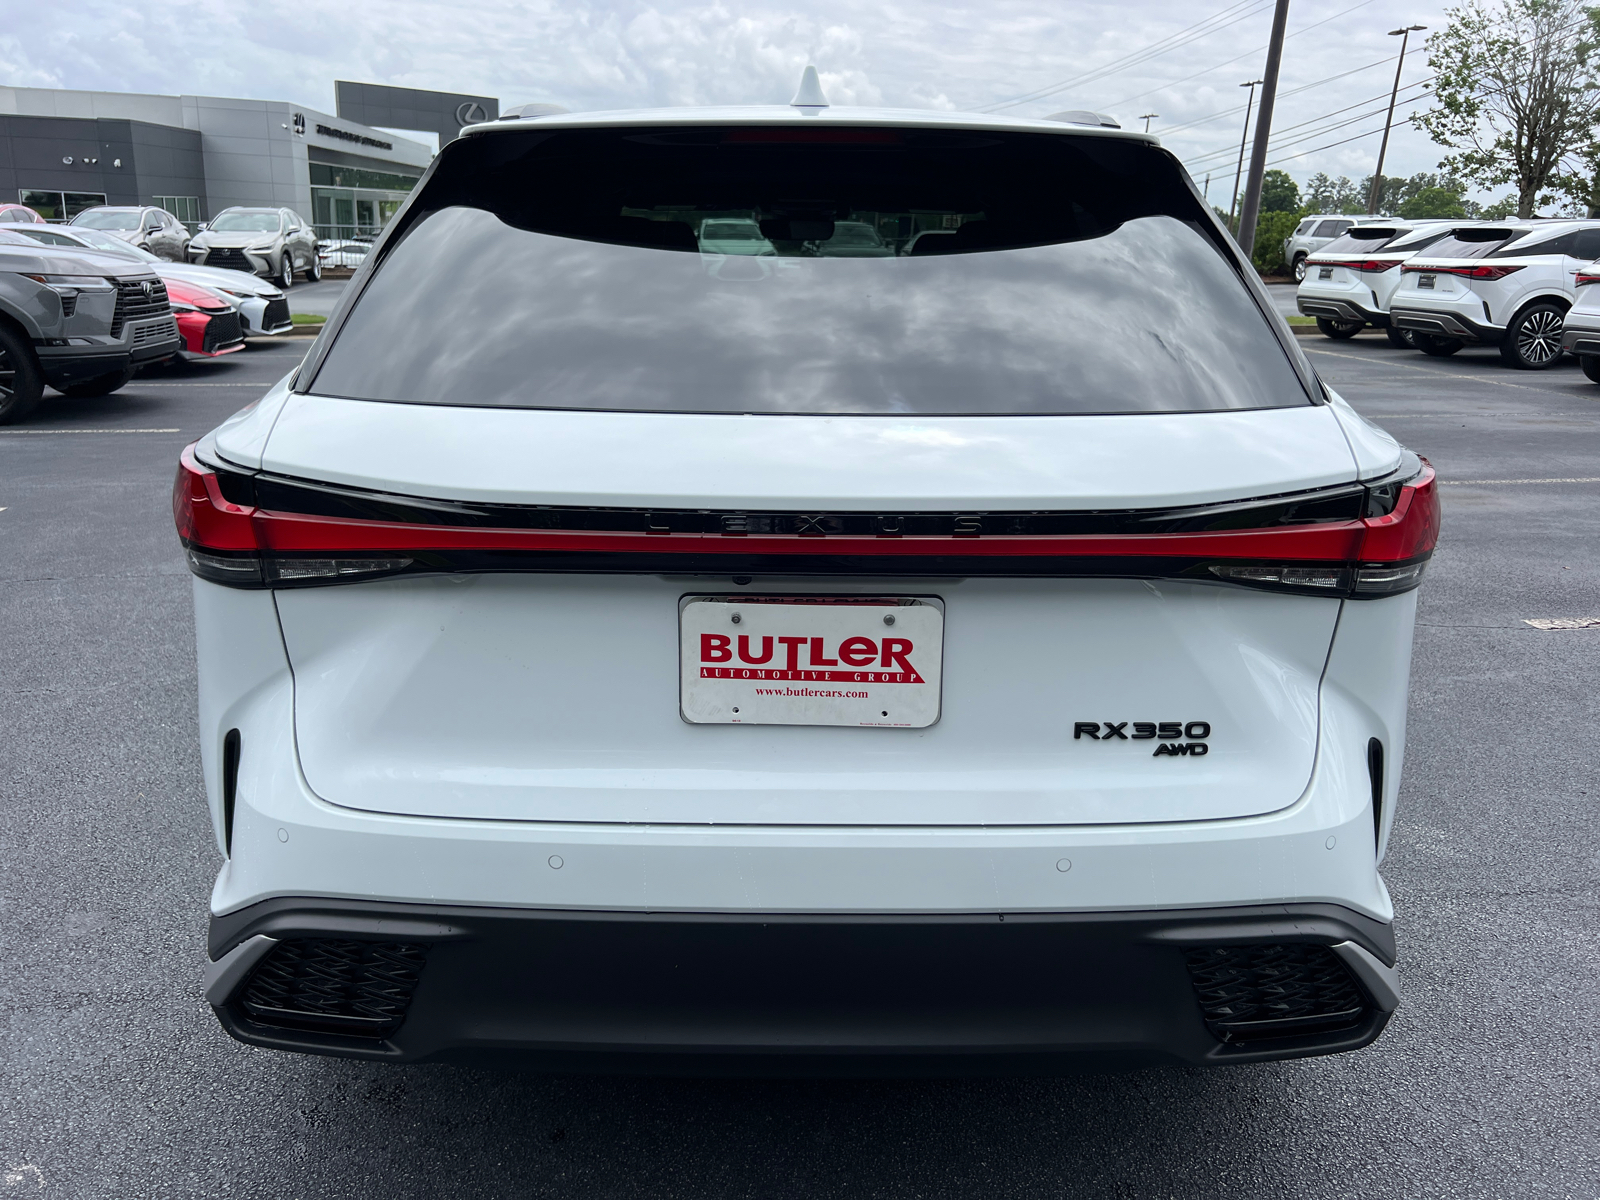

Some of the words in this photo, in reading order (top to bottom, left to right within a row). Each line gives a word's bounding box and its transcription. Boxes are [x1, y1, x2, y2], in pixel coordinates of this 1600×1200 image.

[645, 513, 982, 533] LEXUS
[701, 669, 831, 681] AUTOMOTIVE
[854, 672, 918, 683] GROUP
[755, 687, 869, 699] www.butlercars.com
[1152, 742, 1209, 757] AWD
